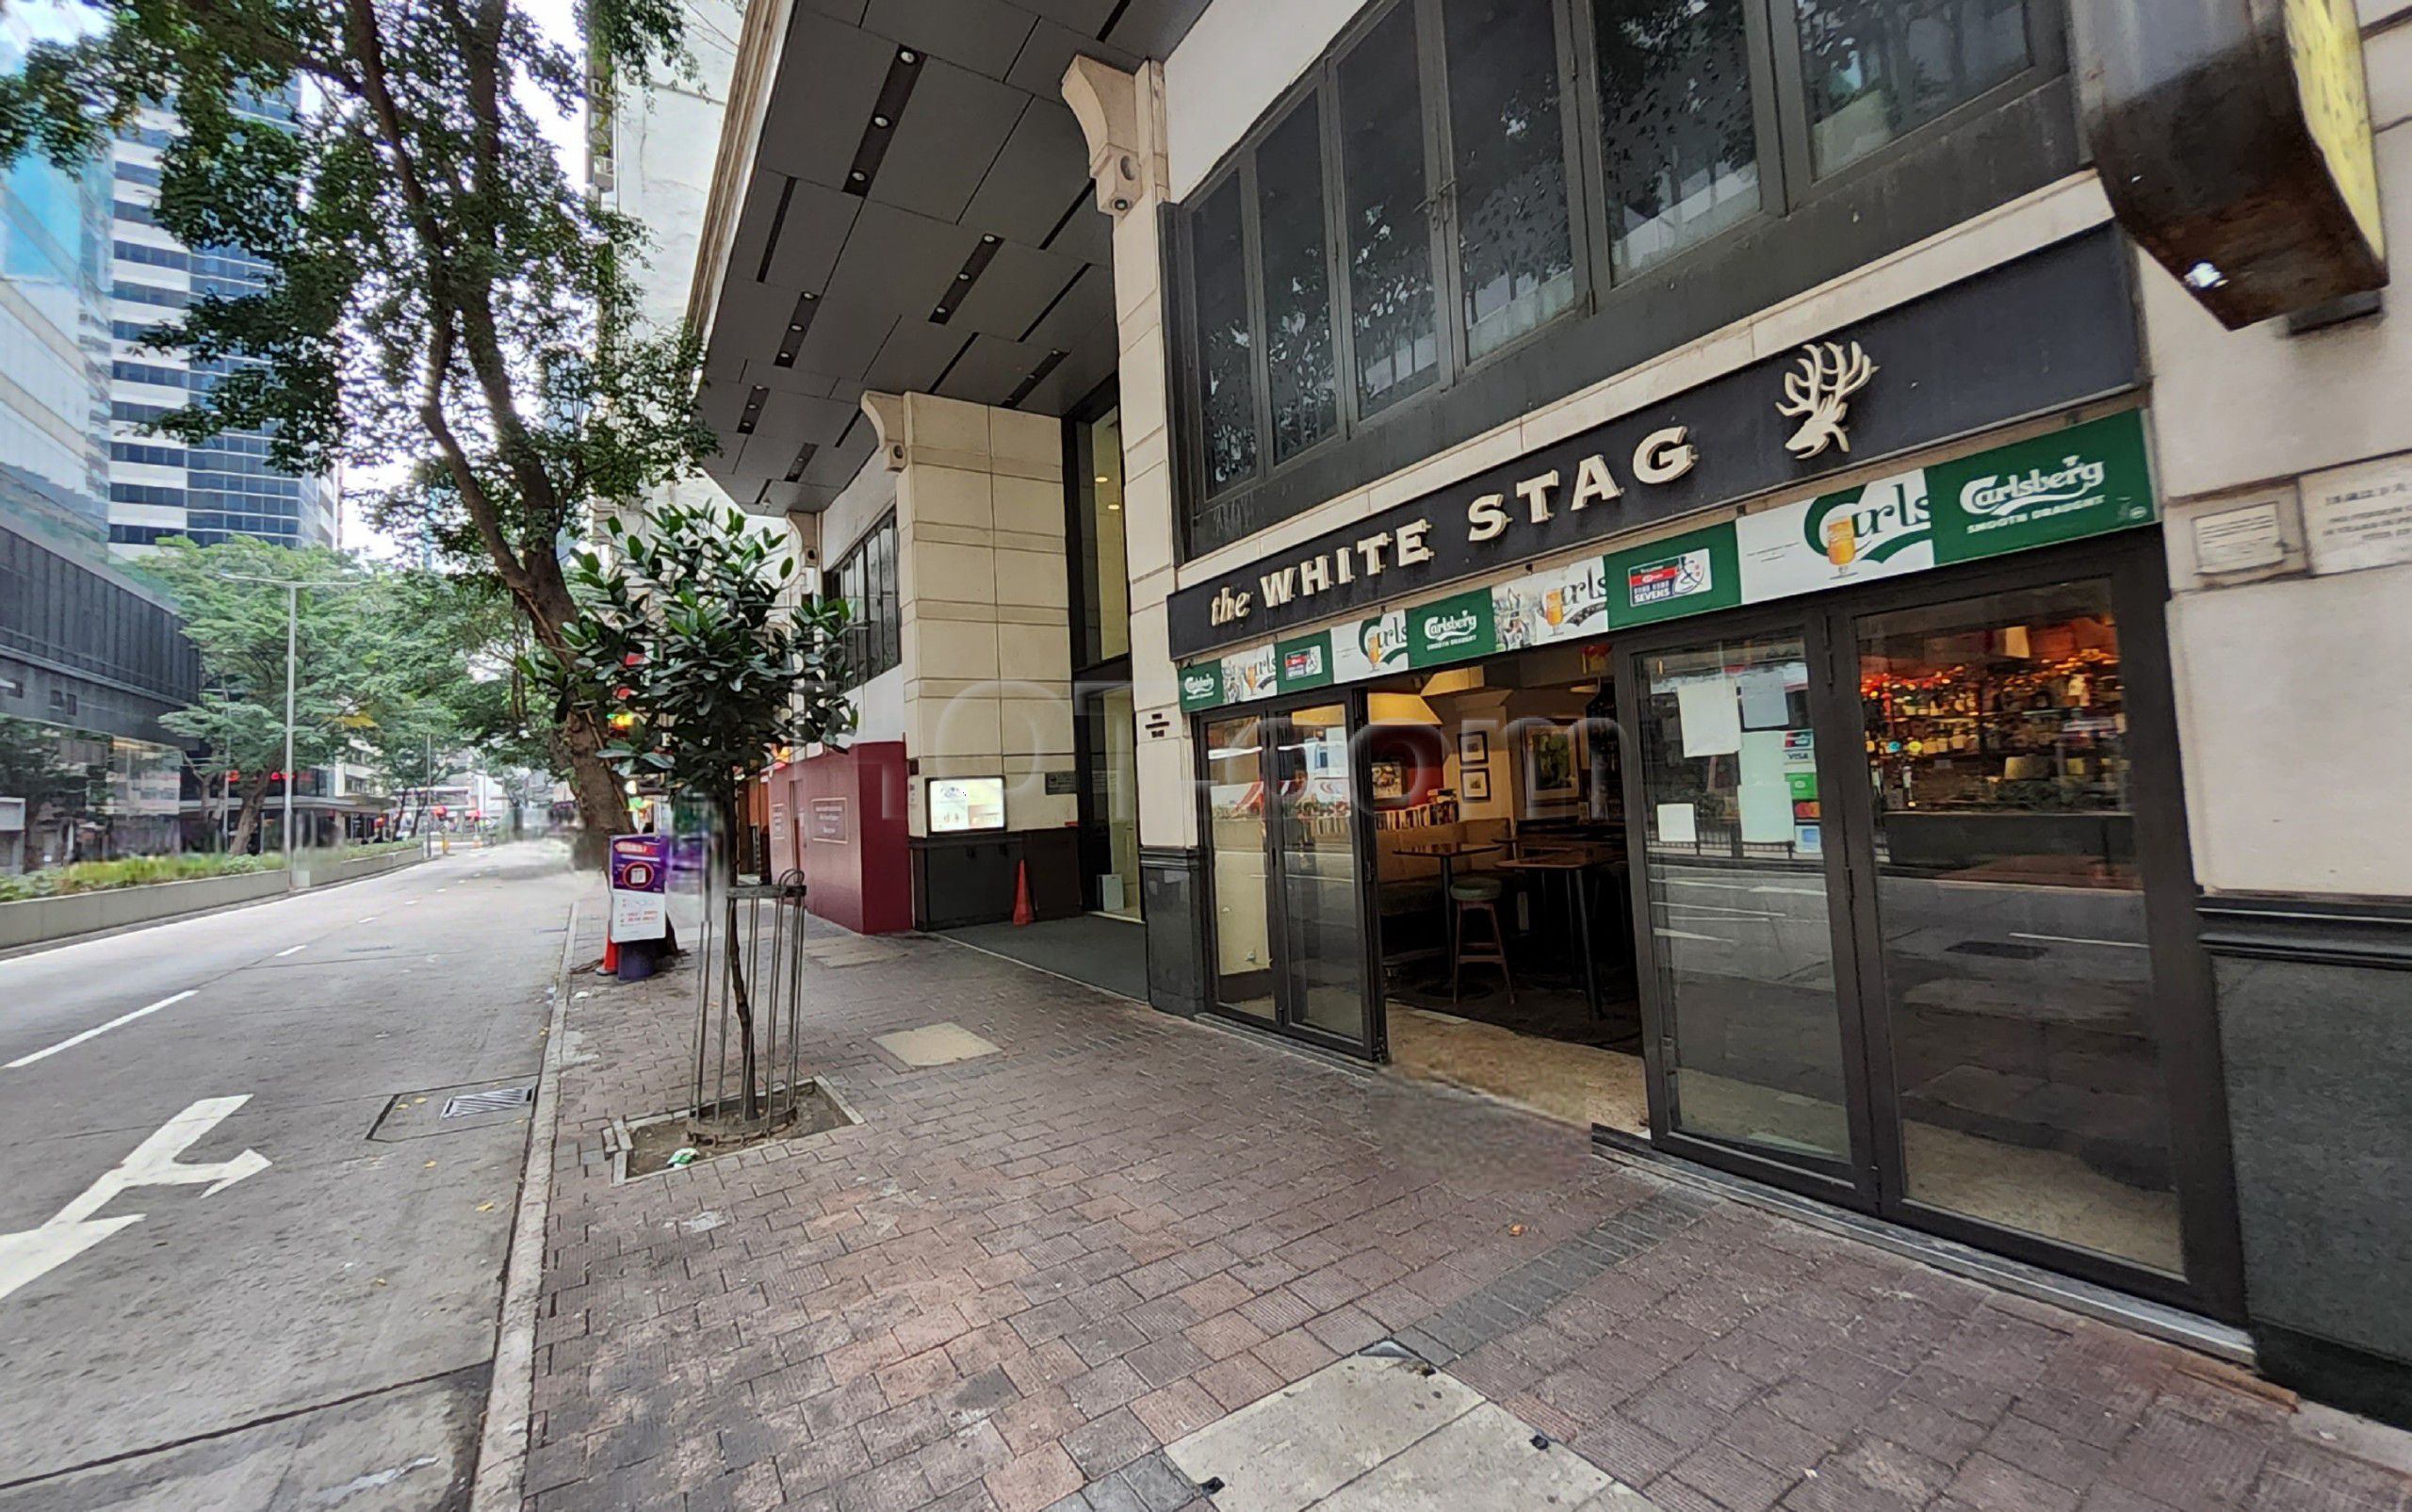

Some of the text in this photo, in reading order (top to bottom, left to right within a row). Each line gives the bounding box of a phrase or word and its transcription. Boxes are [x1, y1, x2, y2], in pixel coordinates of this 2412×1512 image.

[1960, 458, 2105, 515] Carlsberg
[1210, 425, 1699, 627] the WHITE STAG
[1424, 612, 1477, 642] Carlsberg
[1787, 752, 1808, 760] VISA
